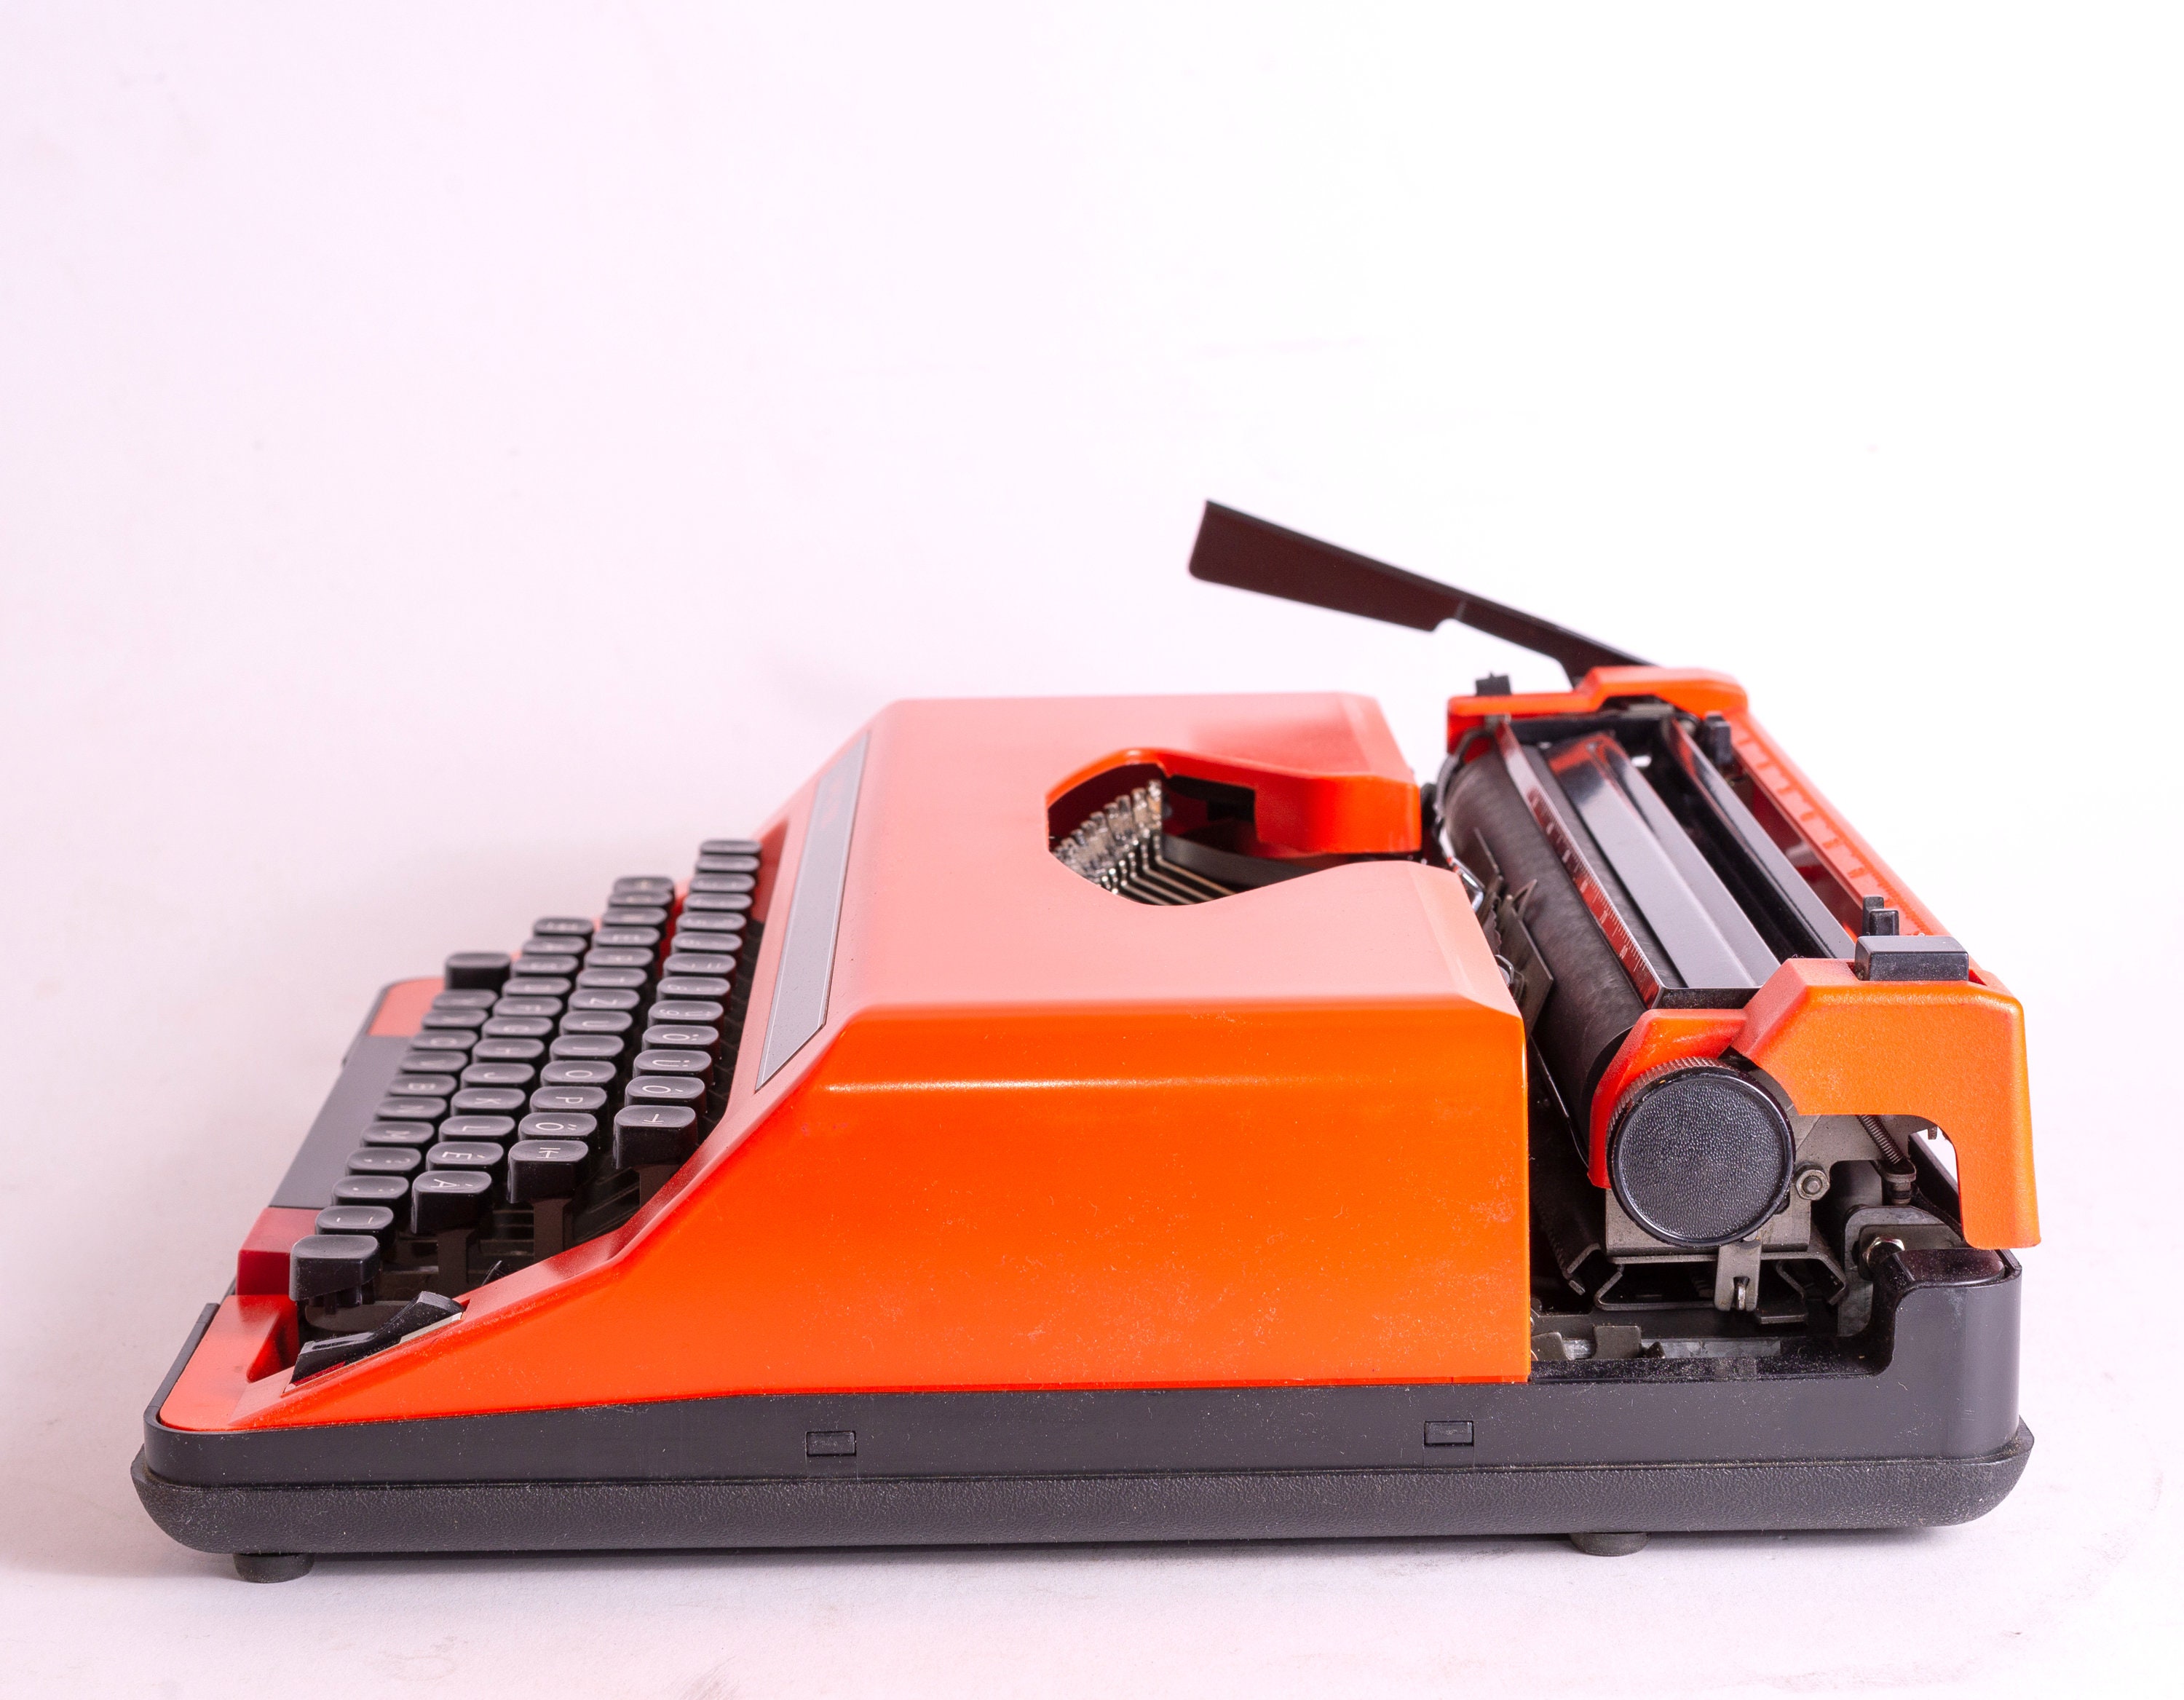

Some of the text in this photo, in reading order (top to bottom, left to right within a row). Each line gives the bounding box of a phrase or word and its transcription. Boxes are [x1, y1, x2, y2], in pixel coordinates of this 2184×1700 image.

[662, 1033, 700, 1041] Ö
[652, 1059, 690, 1068] Ü
[408, 1082, 437, 1091] B
[642, 1085, 684, 1094] Ó
[474, 1097, 502, 1106] K
[555, 1096, 584, 1104] P
[535, 1122, 577, 1131] Ő
[441, 1151, 486, 1161] É
[430, 1179, 474, 1189] Á
